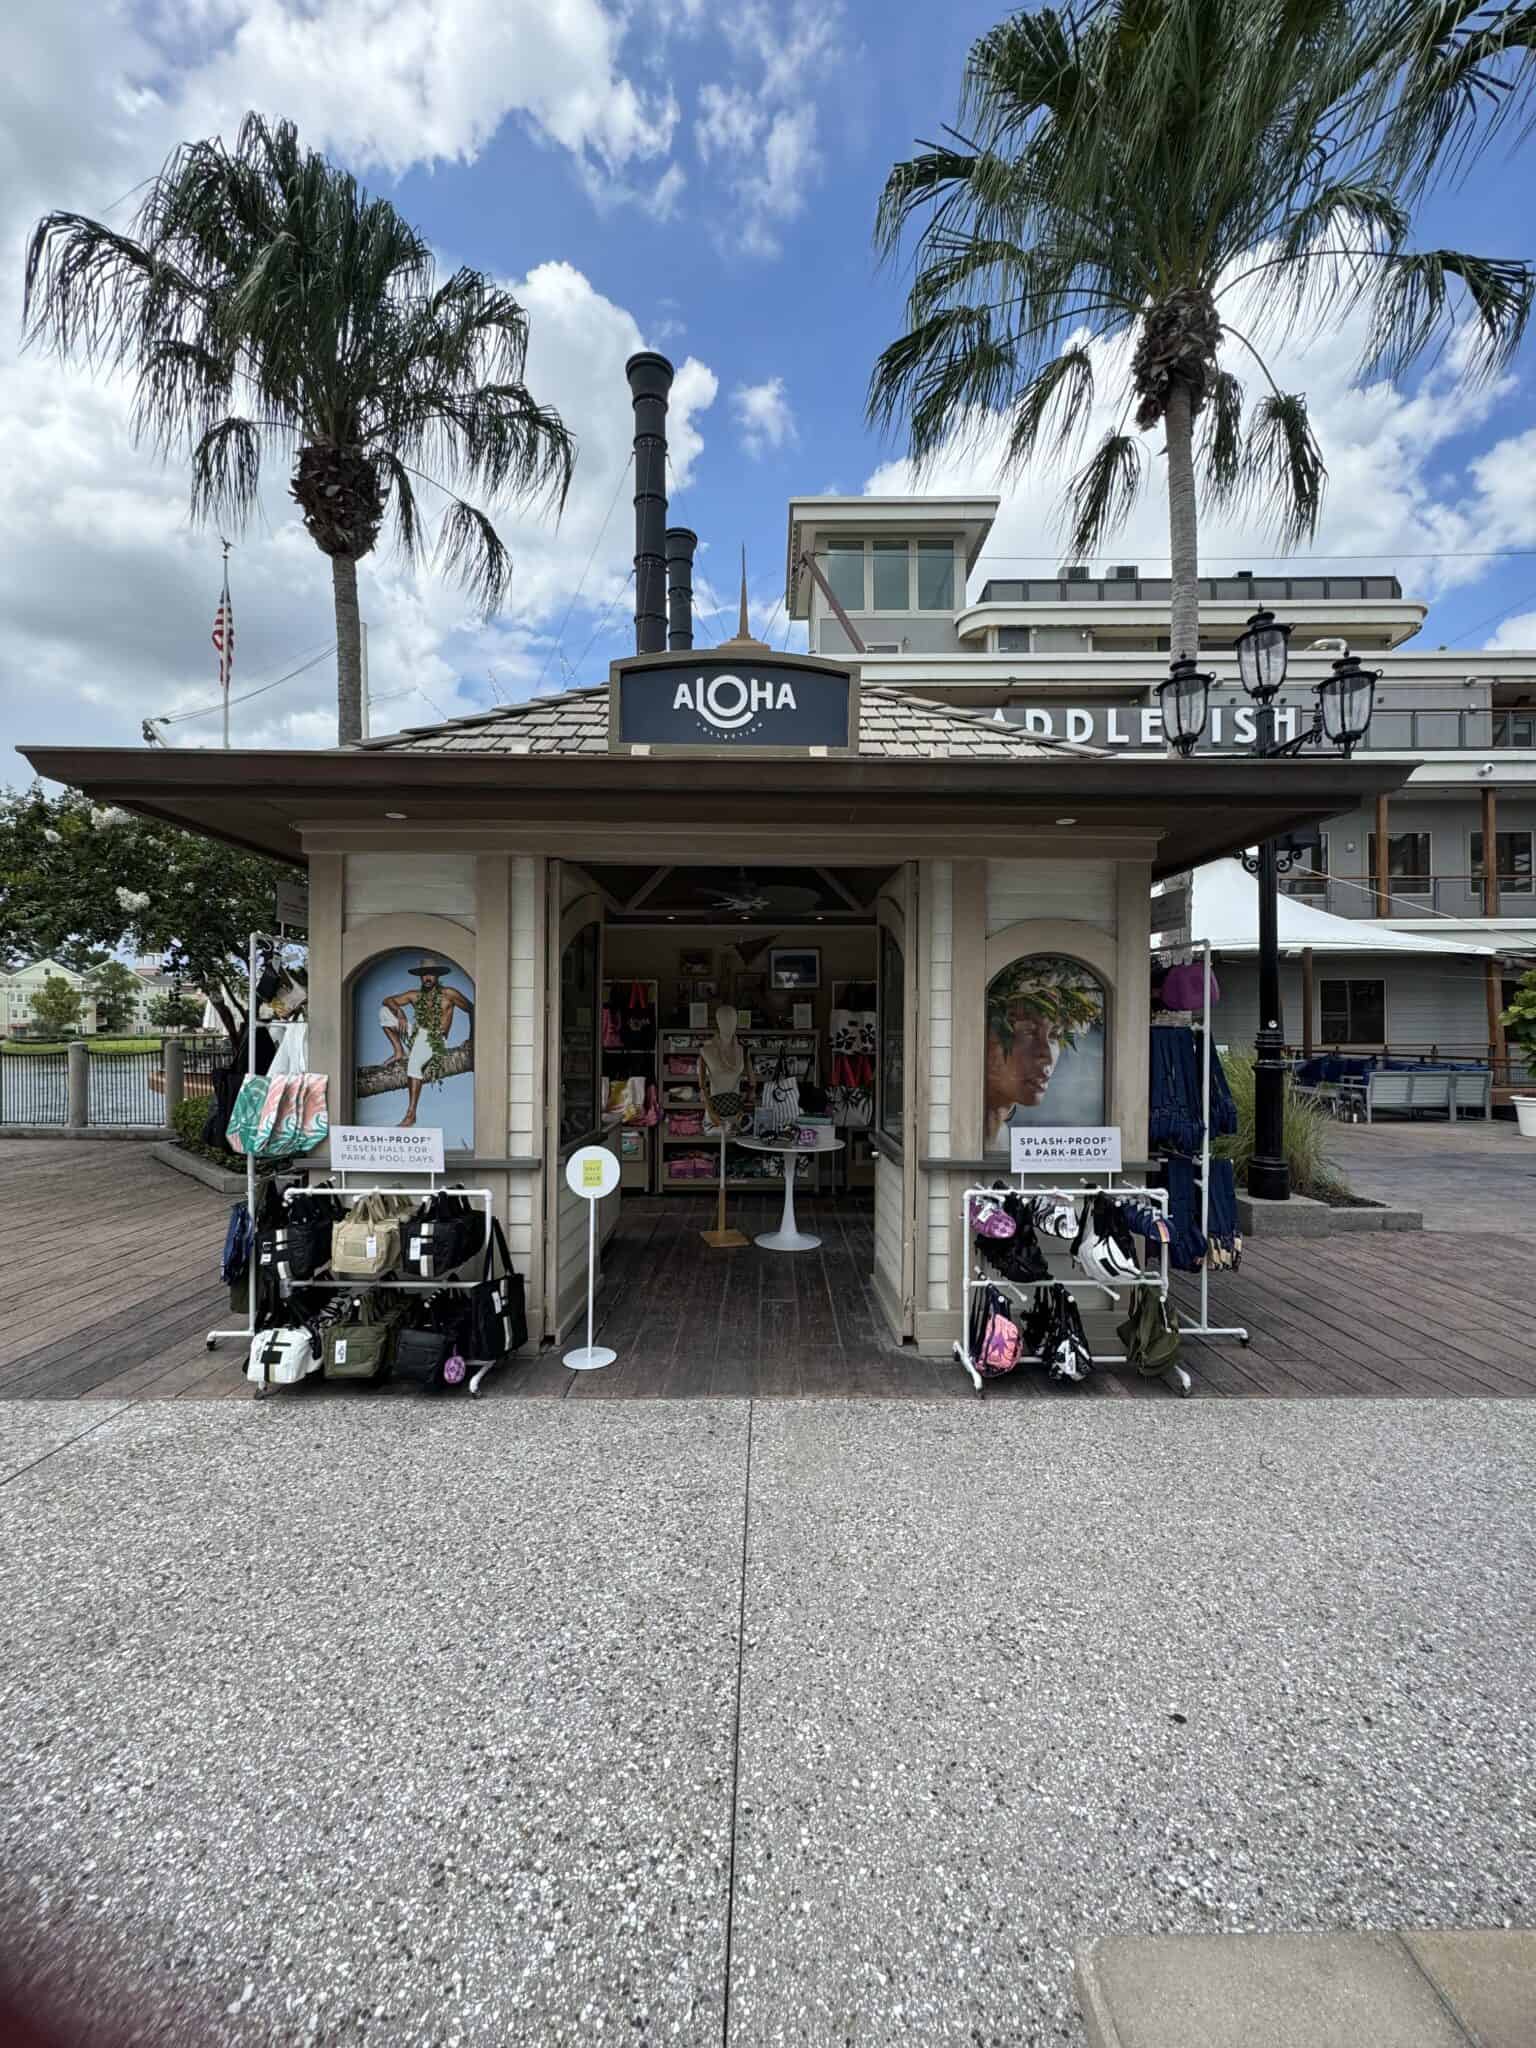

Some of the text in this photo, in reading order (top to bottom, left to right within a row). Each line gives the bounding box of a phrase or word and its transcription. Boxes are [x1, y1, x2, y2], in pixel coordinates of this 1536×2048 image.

[672, 674, 797, 729] ALOHA
[993, 707, 1296, 744] DDLEISH
[344, 1144, 428, 1153] ESSENTIALS FOR
[1024, 1147, 1108, 1157] & PARK-READY
[341, 1153, 434, 1163] PARK & POOL DAYS
